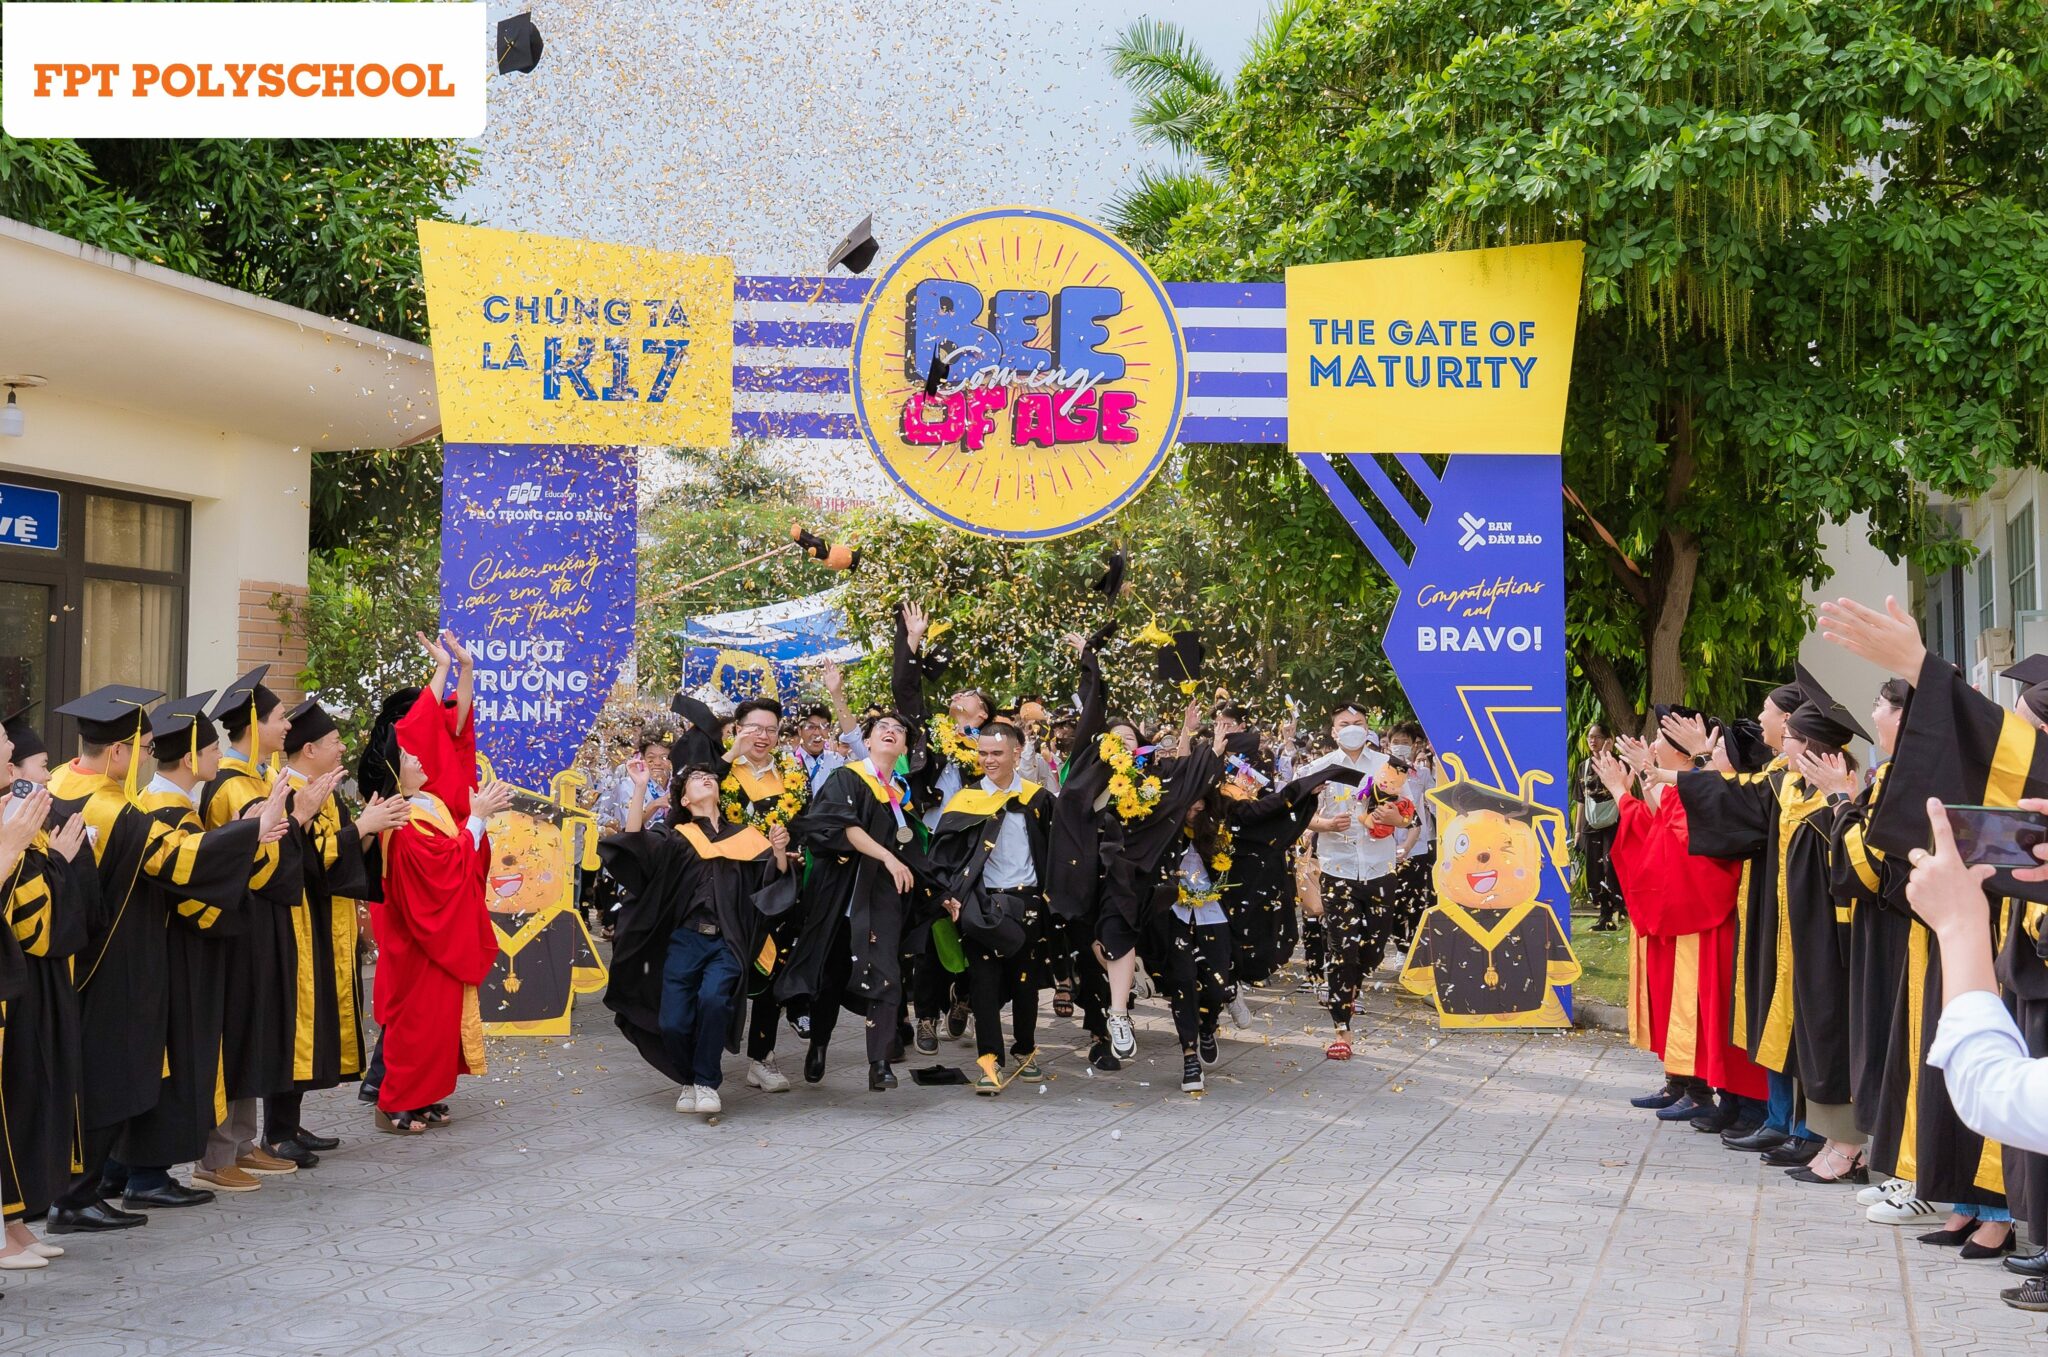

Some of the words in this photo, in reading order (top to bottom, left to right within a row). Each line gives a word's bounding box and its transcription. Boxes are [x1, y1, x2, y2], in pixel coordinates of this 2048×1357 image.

[483, 288, 631, 327] CHÚNG
[643, 298, 691, 328] TA
[905, 278, 1126, 385] BEE
[1309, 319, 1375, 345] THE
[1388, 319, 1478, 346] GATE
[1489, 321, 1535, 347] OF
[482, 333, 530, 371] LÀ
[543, 336, 690, 403] K17
[936, 345, 1105, 416] Coming
[1310, 355, 1538, 389] MATURITY
[900, 385, 1008, 453] OF
[1011, 386, 1139, 448] AGE
[506, 482, 542, 505] FPT
[546, 511, 574, 521] CAO
[1488, 522, 1512, 531] BAN
[469, 557, 534, 590] Chúc
[464, 590, 502, 608] các
[509, 587, 541, 601] em
[1417, 576, 1546, 612] Congratulations
[1462, 597, 1497, 620] and
[1417, 626, 1542, 652] BRAVO!
[472, 660, 589, 692] RƯỞNG
[477, 694, 562, 721] HÀNH
